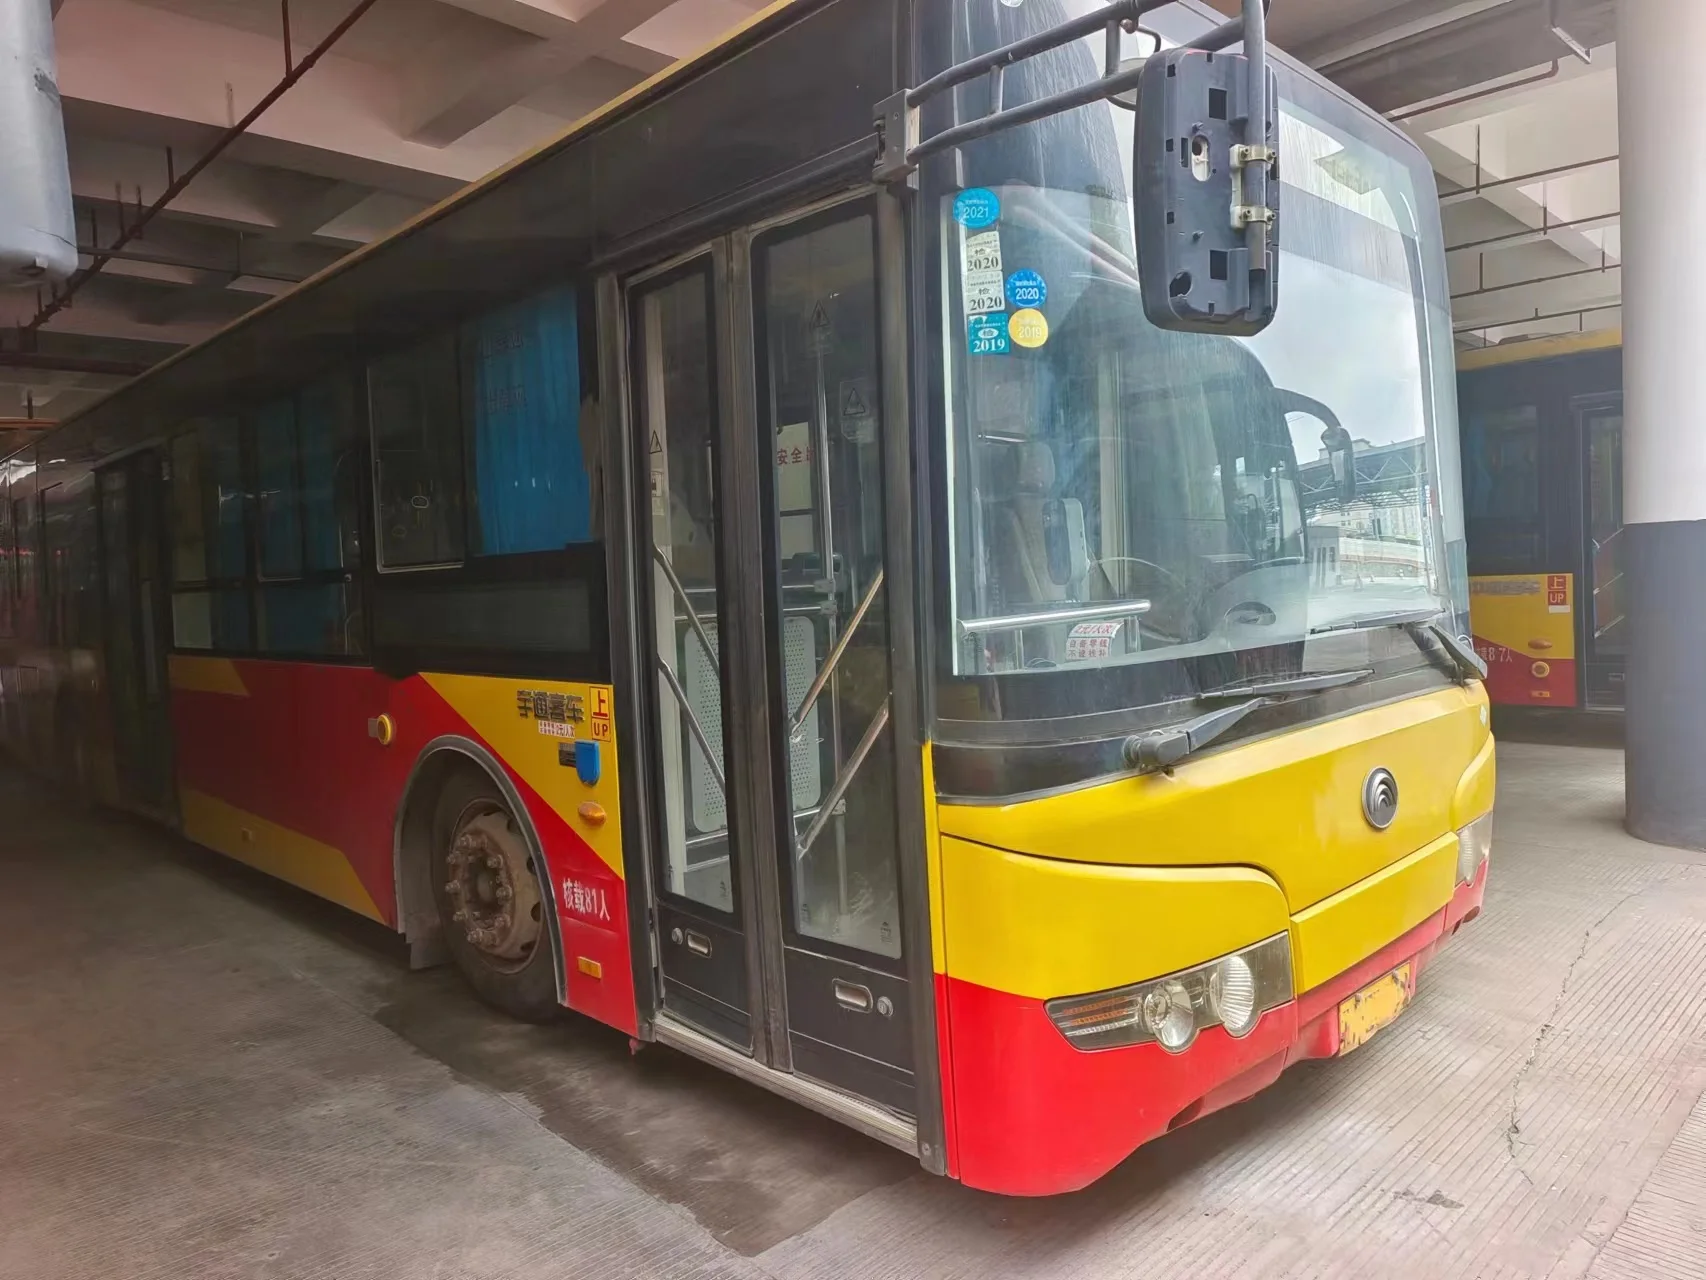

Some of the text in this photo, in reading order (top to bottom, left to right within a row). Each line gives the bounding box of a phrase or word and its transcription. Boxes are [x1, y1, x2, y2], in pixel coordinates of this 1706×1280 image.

[963, 206, 989, 219] 2021
[967, 256, 999, 271] 2020
[1015, 287, 1040, 300] 2020
[970, 296, 1002, 311] 2020
[1018, 325, 1042, 339] 2019
[973, 338, 1005, 353] 2019
[1551, 576, 1564, 589] 上
[1549, 592, 1564, 603] UP
[592, 690, 609, 718] 上
[593, 721, 609, 737] UP
[562, 877, 611, 921] 核载81人
